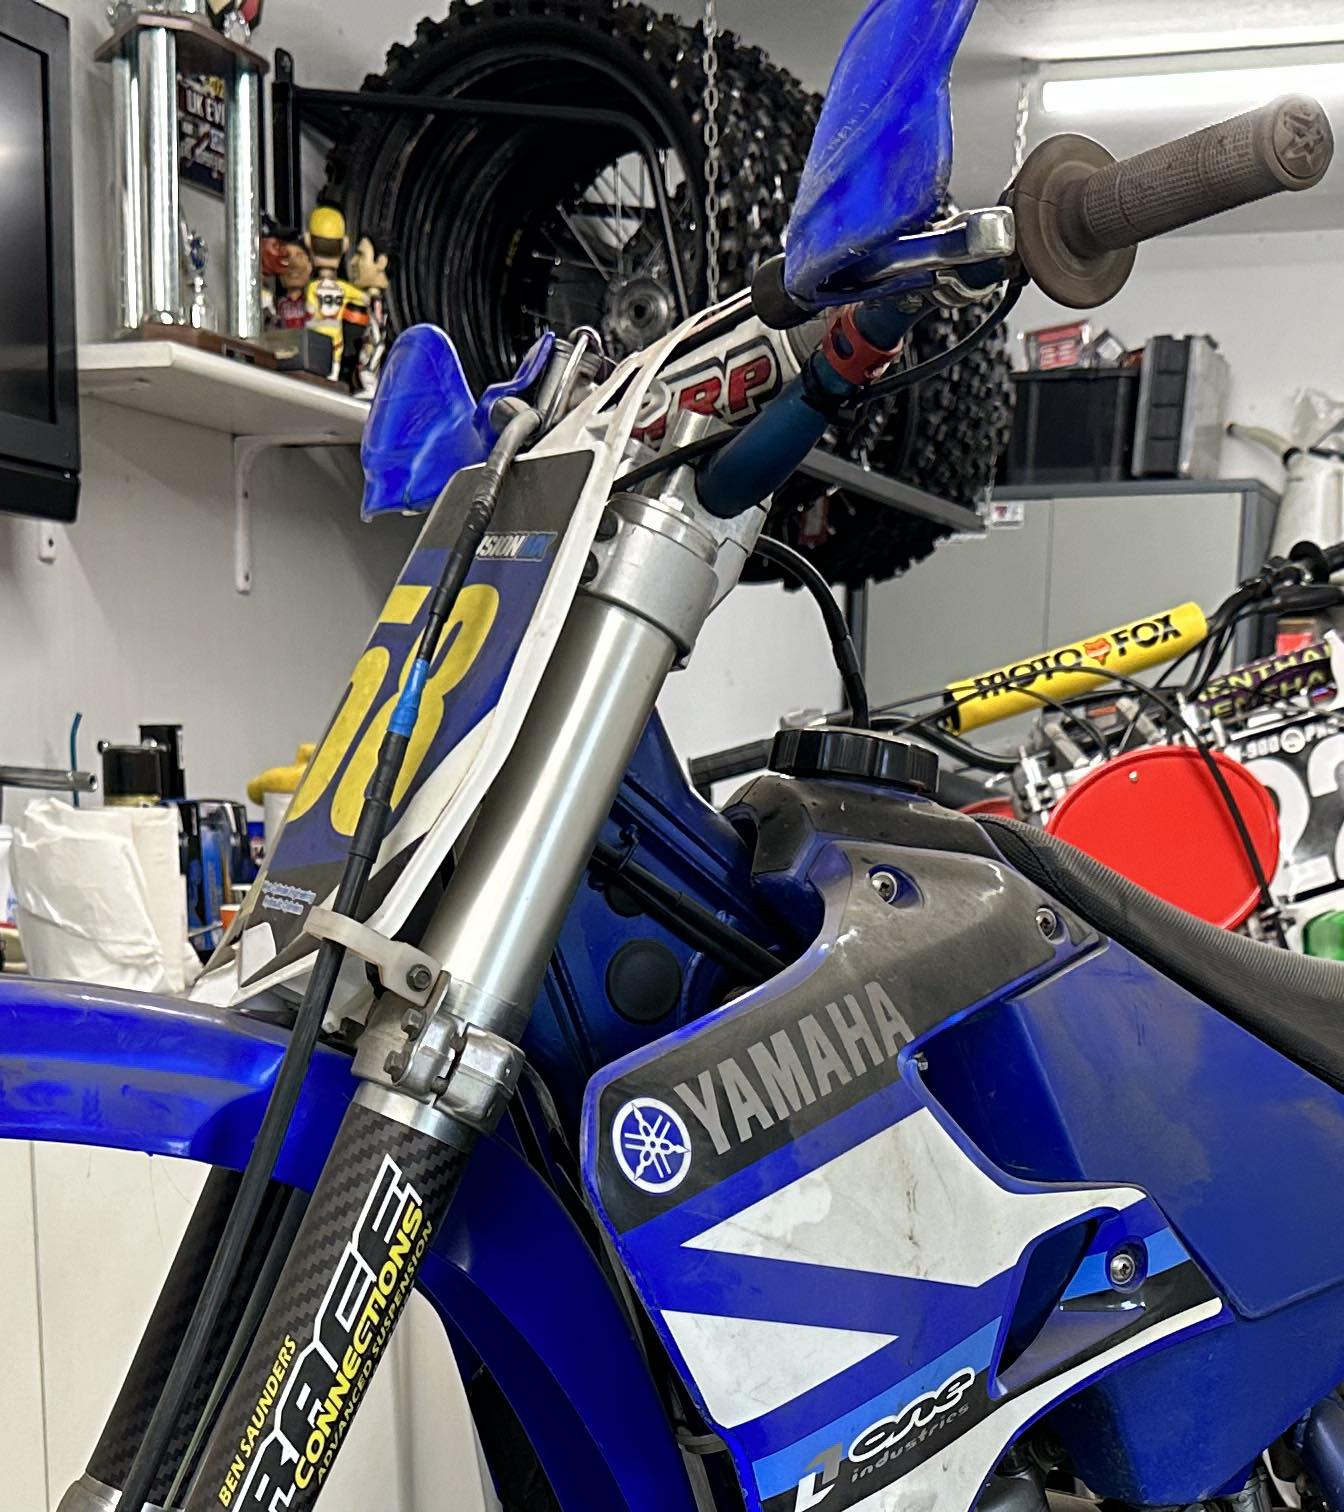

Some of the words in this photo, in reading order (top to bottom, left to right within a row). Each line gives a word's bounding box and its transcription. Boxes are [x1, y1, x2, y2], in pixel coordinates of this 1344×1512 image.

[974, 648, 1083, 700] MOTO
[1111, 614, 1182, 657] FOX
[673, 980, 915, 1155] YAMAHA
[217, 1456, 247, 1508] BEN
[241, 1333, 297, 1456] SAUNDERS
[294, 1202, 424, 1491] CONNECTIONS
[316, 1357, 375, 1486] ADVANCED
[371, 1218, 433, 1357] SUSPENSION
[850, 1402, 972, 1485] industries
